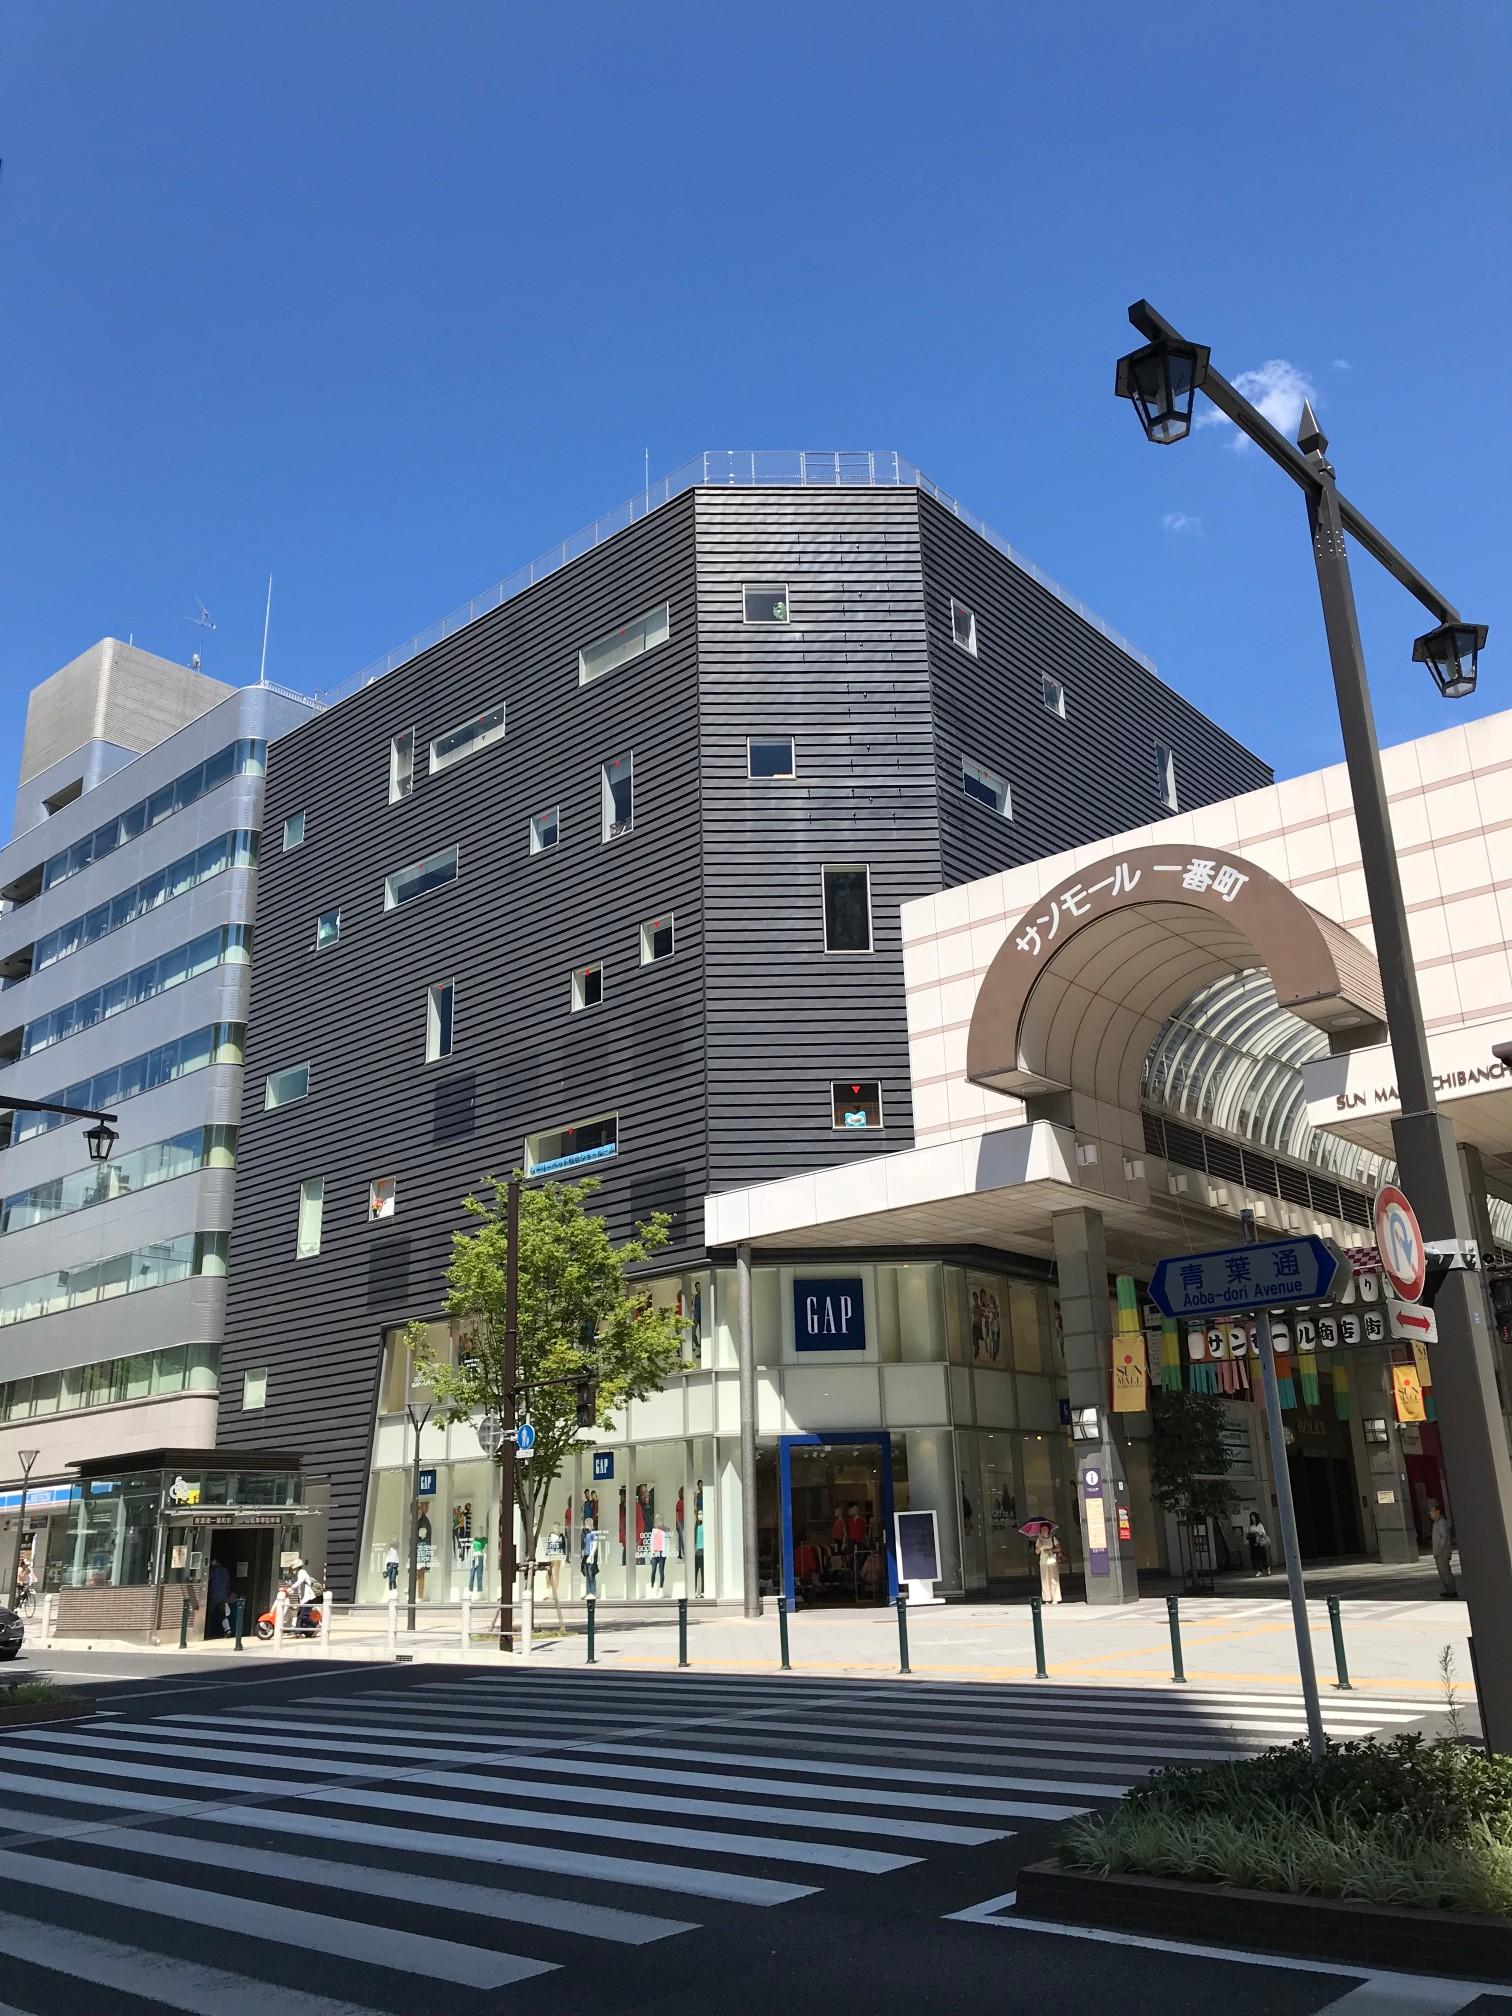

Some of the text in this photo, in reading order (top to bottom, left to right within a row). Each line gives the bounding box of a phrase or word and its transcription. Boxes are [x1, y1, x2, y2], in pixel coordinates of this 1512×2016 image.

[1015, 858, 1250, 956] サンモール 一番町
[1336, 1061, 1512, 1111] SUN MA CHIBANCH
[1179, 1248, 1300, 1292] 青葉通
[1183, 1279, 1303, 1308] Aoba-dori Avenue
[806, 1295, 853, 1335] GAP
[1116, 1364, 1143, 1377] SUN
[1117, 1376, 1143, 1385] MALL
[595, 1458, 609, 1475] GAP
[420, 1475, 432, 1490] GAP
